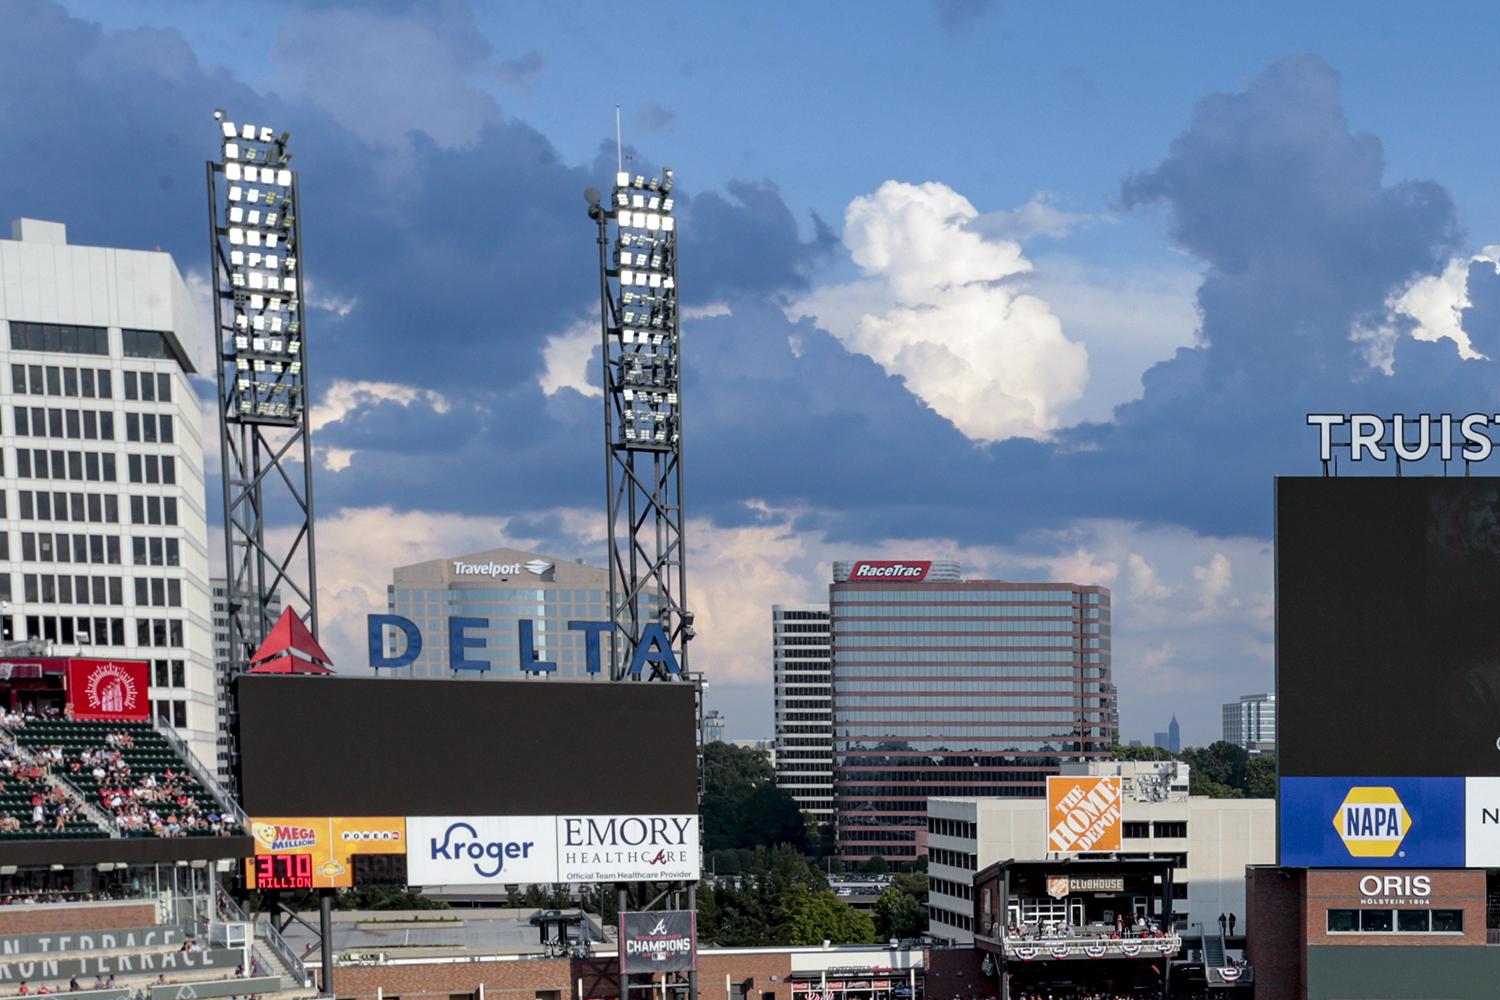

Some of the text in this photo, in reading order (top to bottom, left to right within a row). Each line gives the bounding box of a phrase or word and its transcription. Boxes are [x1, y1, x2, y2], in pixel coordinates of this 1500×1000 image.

[453, 560, 521, 576] Travelport
[856, 563, 923, 579] RaceTrac
[367, 614, 681, 673] DELTA
[1056, 786, 1086, 814] THE
[1049, 776, 1120, 851] HOME
[1347, 807, 1400, 837] NAPA
[275, 826, 315, 840] MEGA
[564, 817, 692, 846] EMORY
[1077, 804, 1120, 851] DEPOT
[272, 840, 315, 850] MILLIONS
[431, 823, 533, 877] Kroger
[566, 848, 687, 864] HEALTHCARE
[258, 855, 311, 877] 370
[595, 872, 616, 880] Team
[660, 870, 692, 879] Provider
[259, 878, 311, 888] MILLION
[1070, 879, 1123, 891] CLUBHOUSE
[1359, 875, 1431, 896] ORIS
[627, 938, 690, 952] CHAMPIONS
